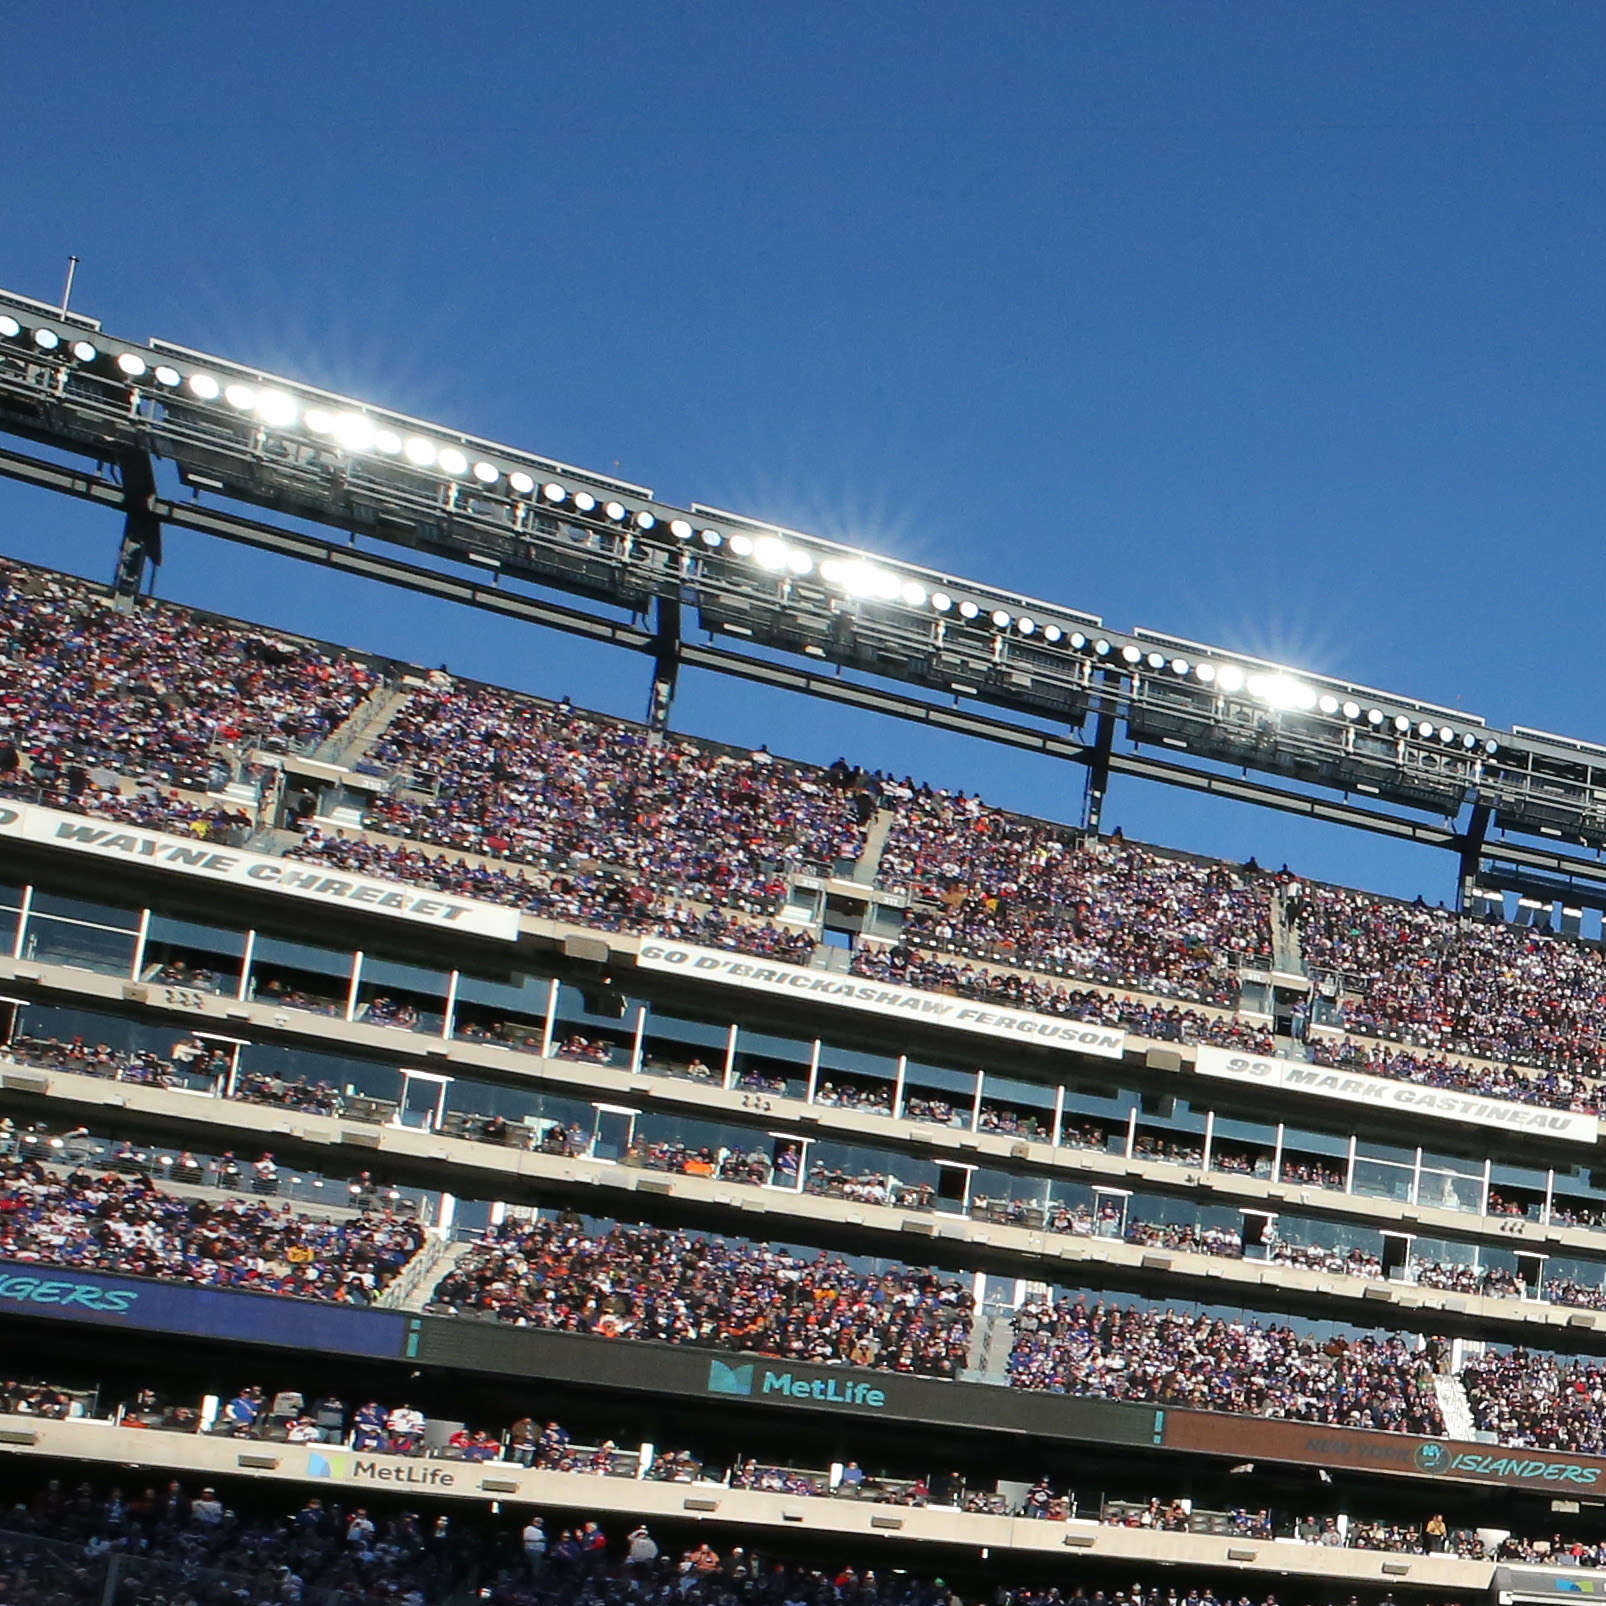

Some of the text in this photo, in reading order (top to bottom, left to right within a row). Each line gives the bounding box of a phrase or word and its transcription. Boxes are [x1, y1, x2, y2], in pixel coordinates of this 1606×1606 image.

[55, 822, 474, 921] WAYNE CHREBET
[640, 946, 1123, 1049] 60 D'BRICKASHAW FERGUSON
[1225, 1058, 1573, 1131] 99 MARK GASTINEAU
[0, 1274, 139, 1312] GERS
[763, 1372, 886, 1407] MetLife
[353, 1459, 455, 1486] MetLife
[1451, 1453, 1602, 1484] ISLANDERS
